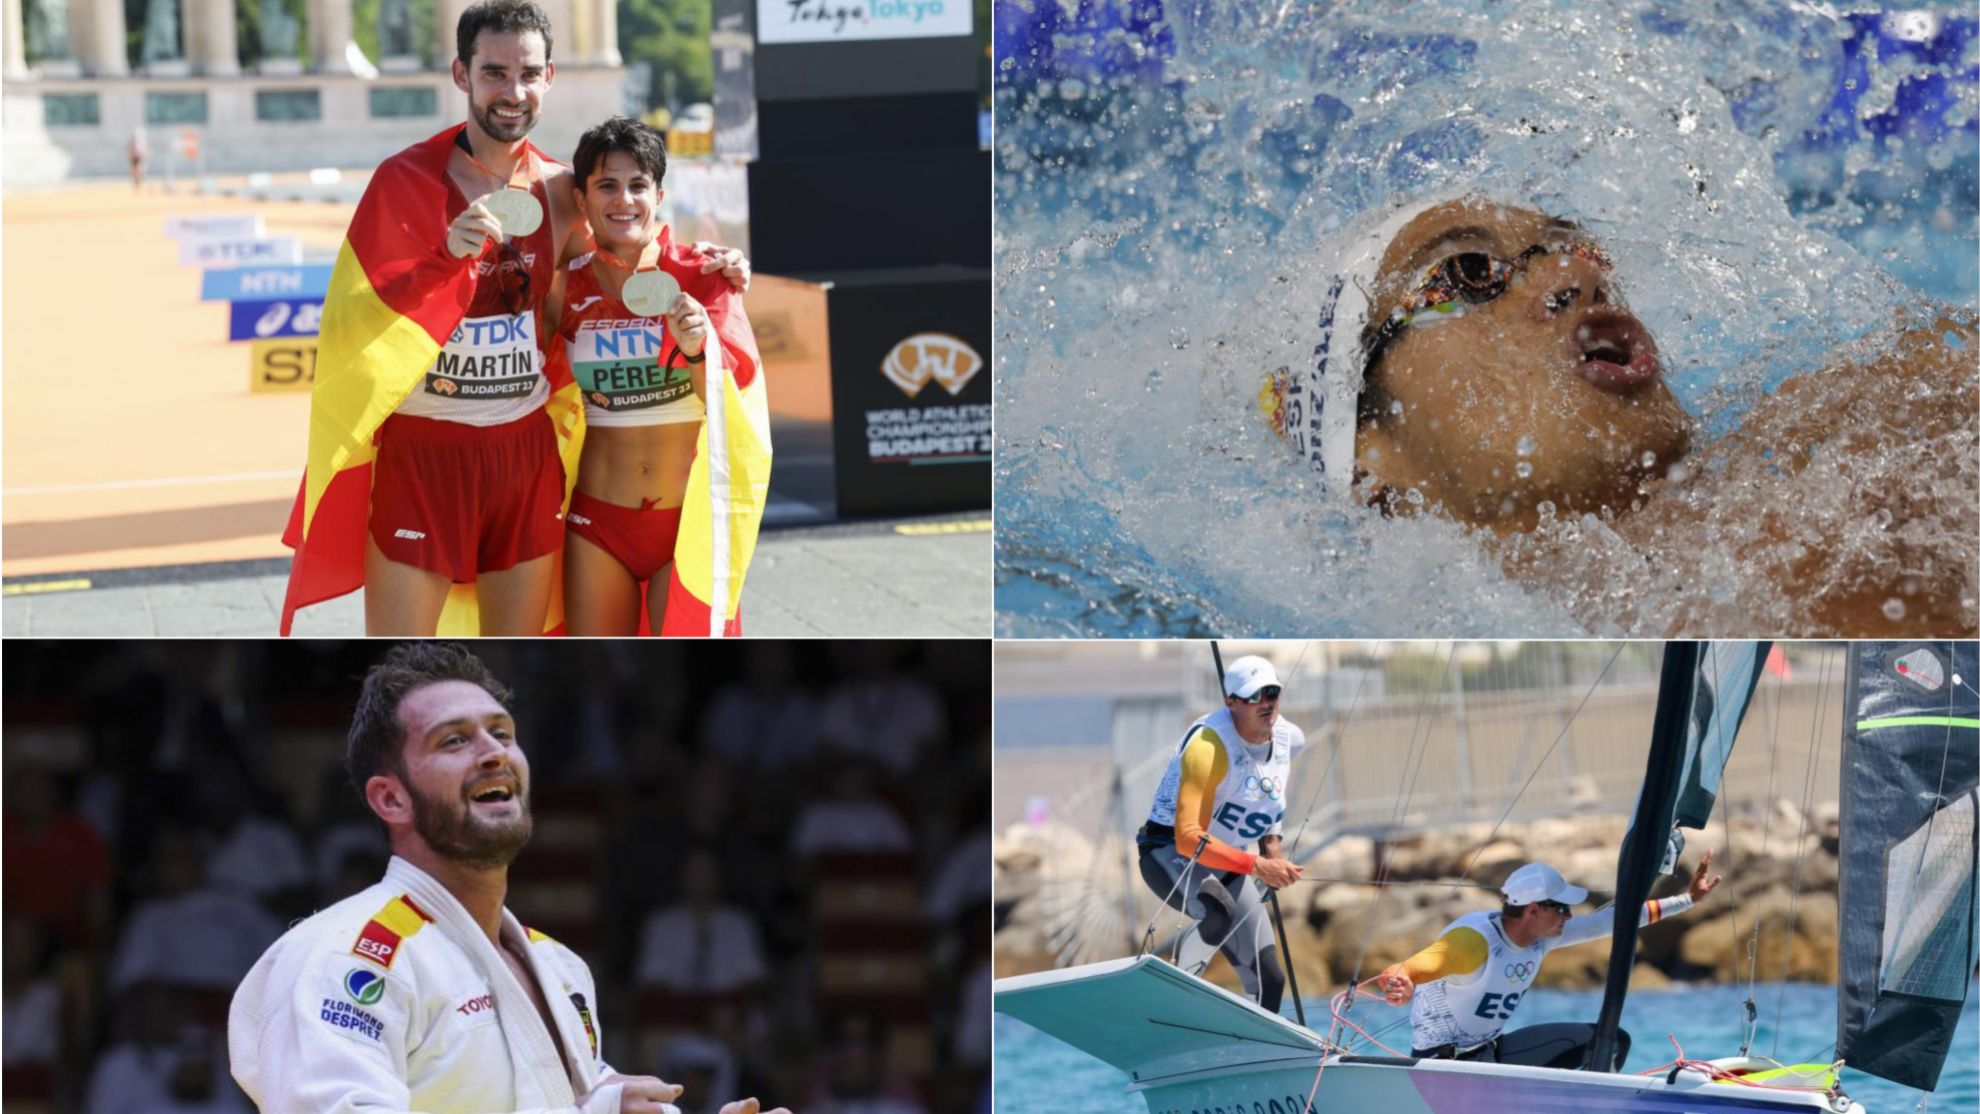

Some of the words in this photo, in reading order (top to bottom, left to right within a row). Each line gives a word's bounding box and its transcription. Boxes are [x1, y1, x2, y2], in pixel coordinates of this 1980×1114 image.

[465, 315, 529, 346] TDK
[594, 326, 664, 359] NTN
[436, 347, 532, 378] MARTÍN
[461, 382, 520, 395] BUDAPEST
[612, 387, 678, 406] BUDAPEST
[866, 408, 921, 424] WORLD
[869, 436, 978, 457] BUDAPEST
[358, 937, 393, 957] ESP
[320, 1008, 383, 1043] DESPREZ
[321, 998, 385, 1032] FLORIMOND
